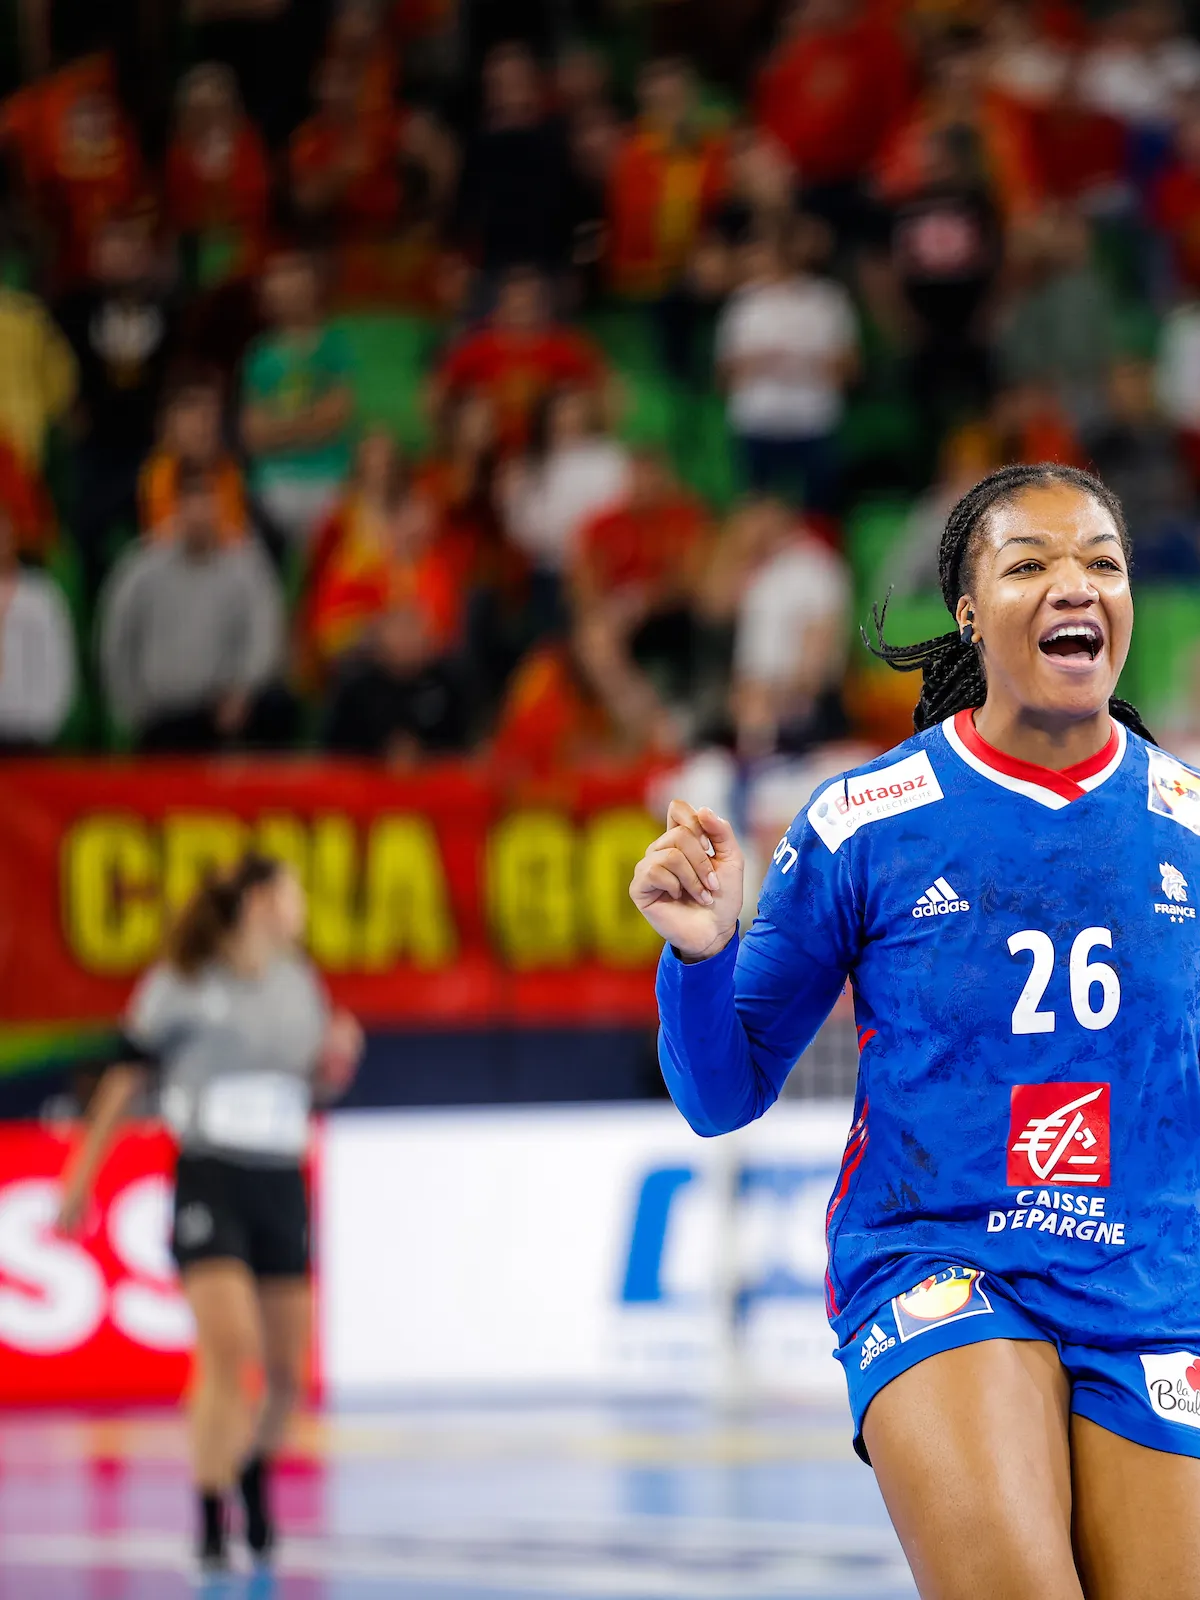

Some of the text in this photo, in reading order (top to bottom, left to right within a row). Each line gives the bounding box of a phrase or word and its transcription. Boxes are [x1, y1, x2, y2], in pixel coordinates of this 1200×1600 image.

[834, 775, 928, 815] Butagaz
[912, 899, 970, 919] adidas
[1006, 926, 1121, 1035] 26
[1015, 1190, 1106, 1217] CAISSE
[986, 1209, 1126, 1246] D'EPARGNE
[1176, 1379, 1190, 1397] la
